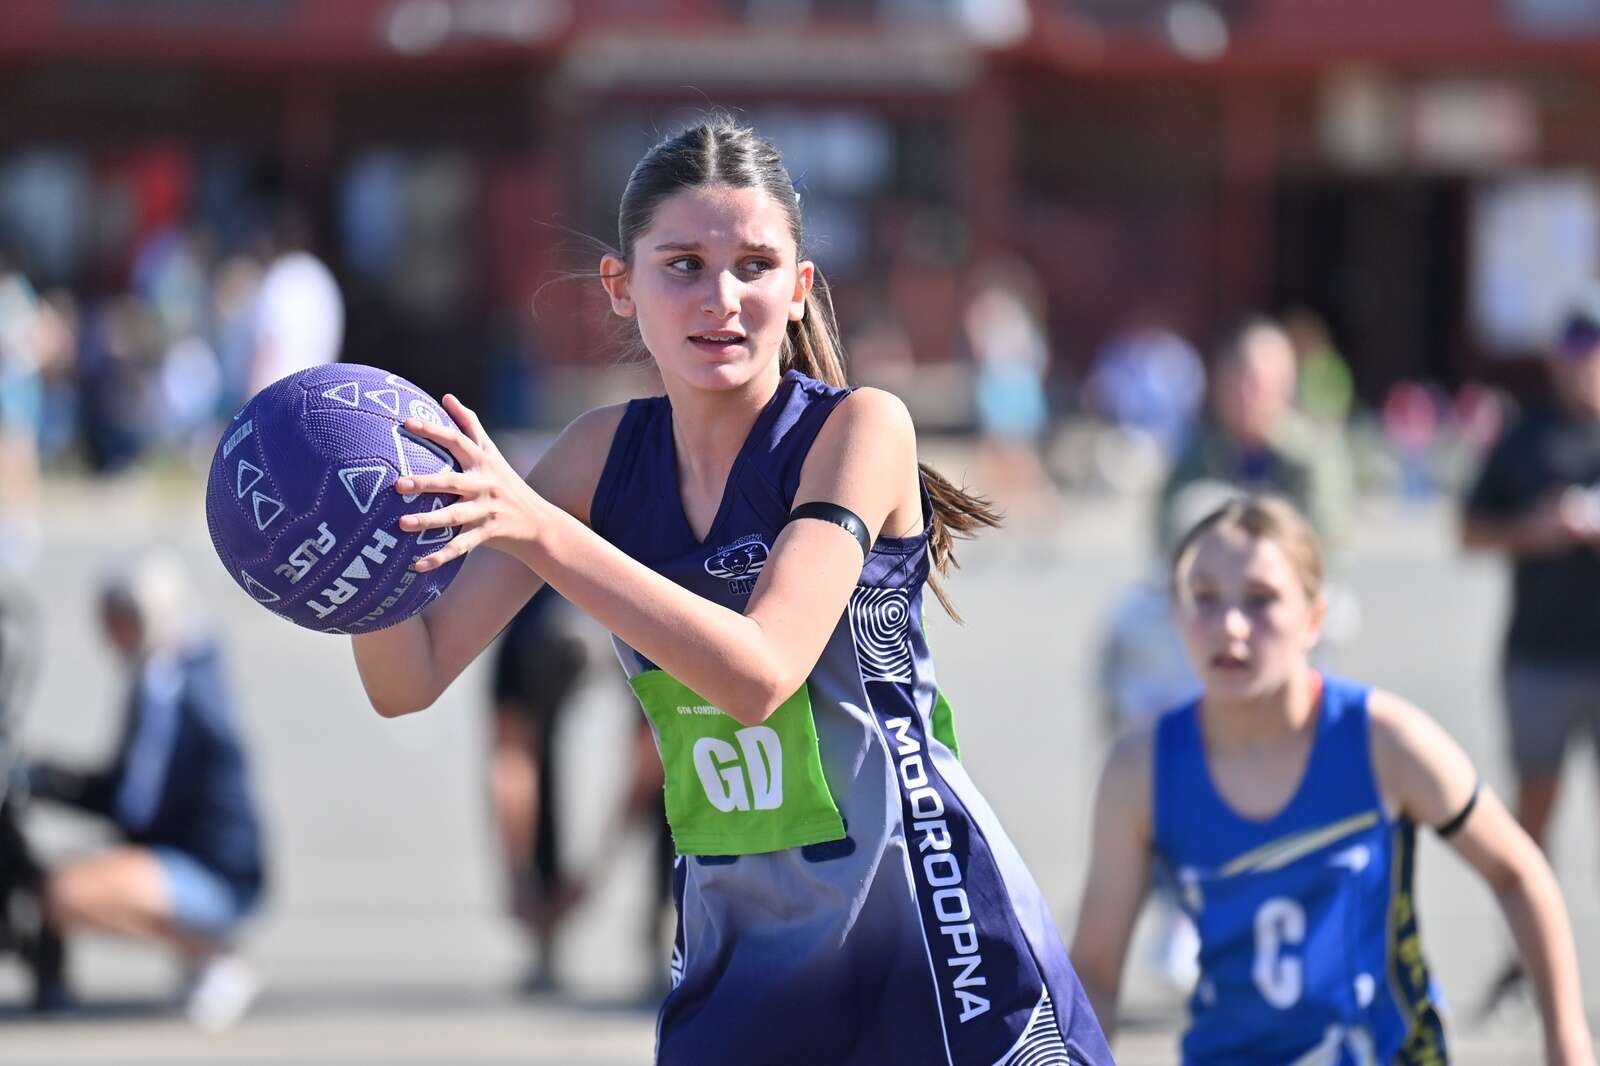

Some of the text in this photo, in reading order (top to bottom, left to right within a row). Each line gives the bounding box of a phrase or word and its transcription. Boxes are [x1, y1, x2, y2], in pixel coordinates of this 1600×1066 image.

[273, 521, 337, 585] FUSE
[305, 528, 398, 620] HART
[692, 725, 784, 813] GD
[884, 715, 991, 1025] MOOROOPNA
[1253, 896, 1307, 1011] C
